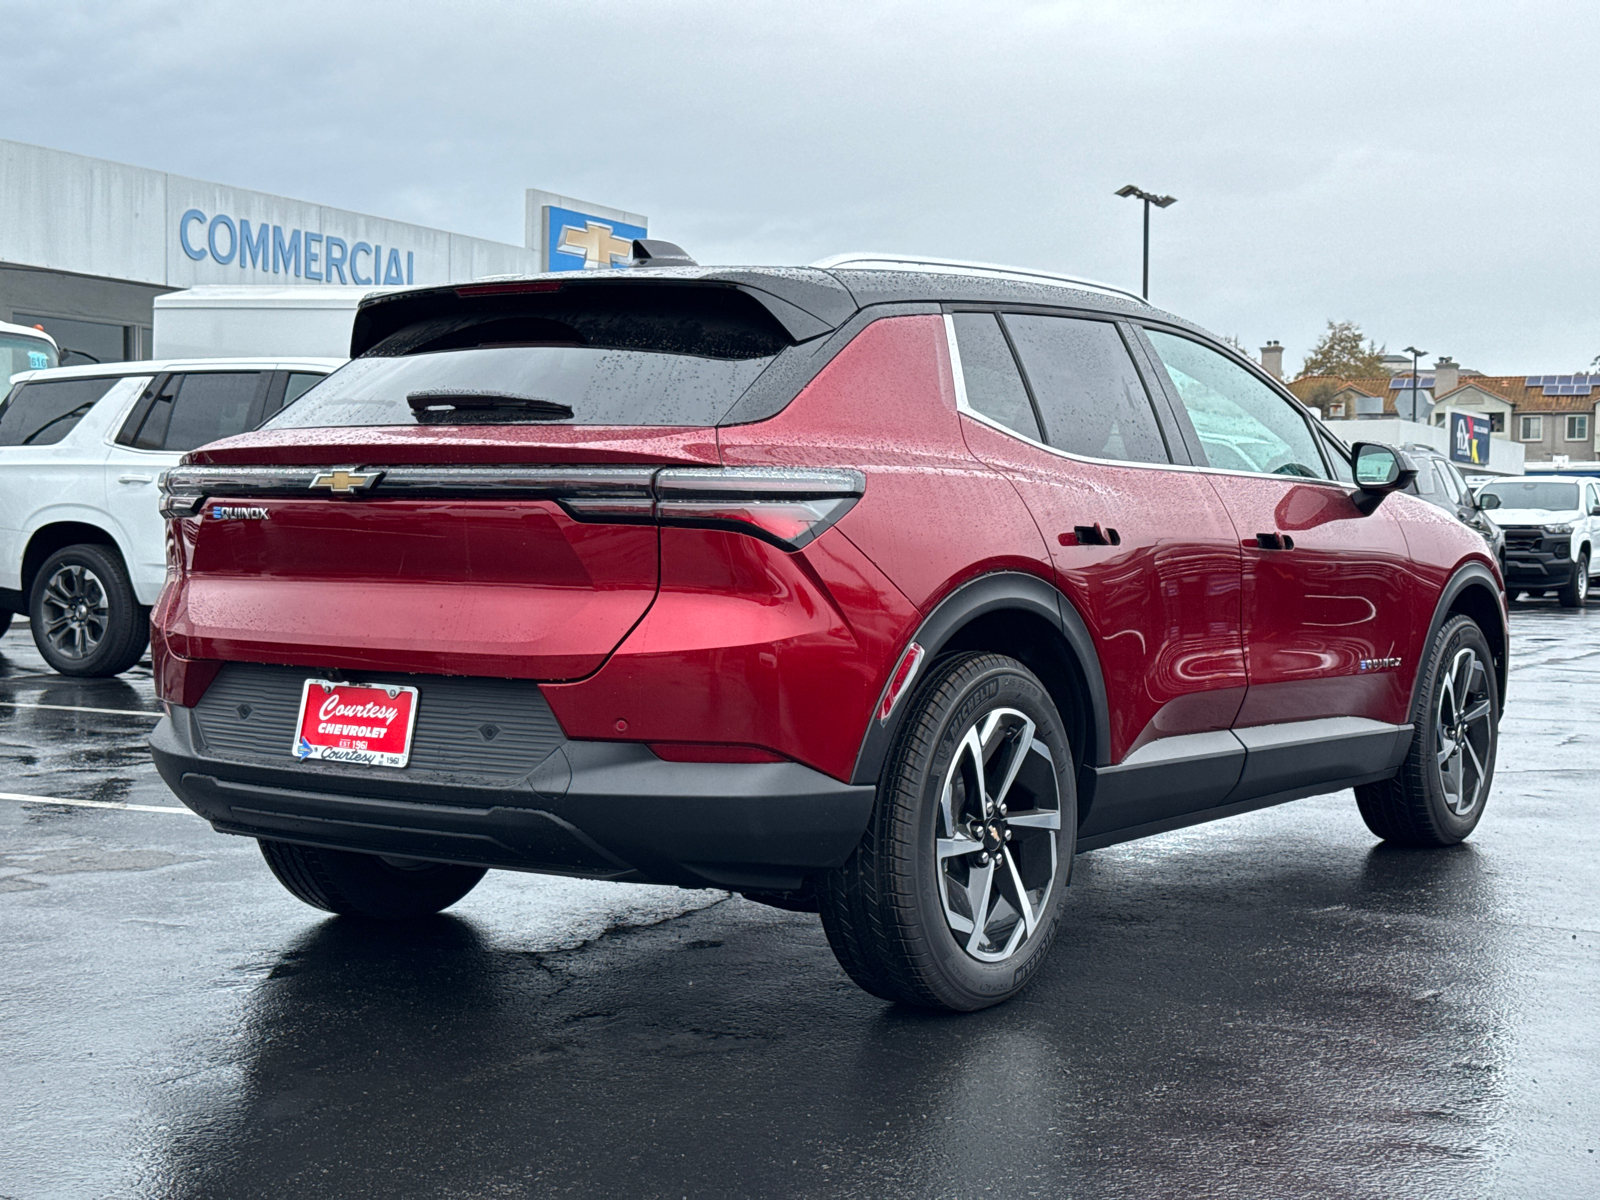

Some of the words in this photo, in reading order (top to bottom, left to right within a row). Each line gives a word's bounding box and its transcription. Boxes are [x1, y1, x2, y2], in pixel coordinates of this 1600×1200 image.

[31, 356, 47, 368] 616
[213, 506, 269, 520] EQUINOX
[318, 694, 398, 725] Courtesy
[949, 680, 998, 740] MICHELIN
[318, 723, 387, 738] CHEVROLET
[352, 740, 368, 749] 1961
[321, 746, 376, 765] Courtesy
